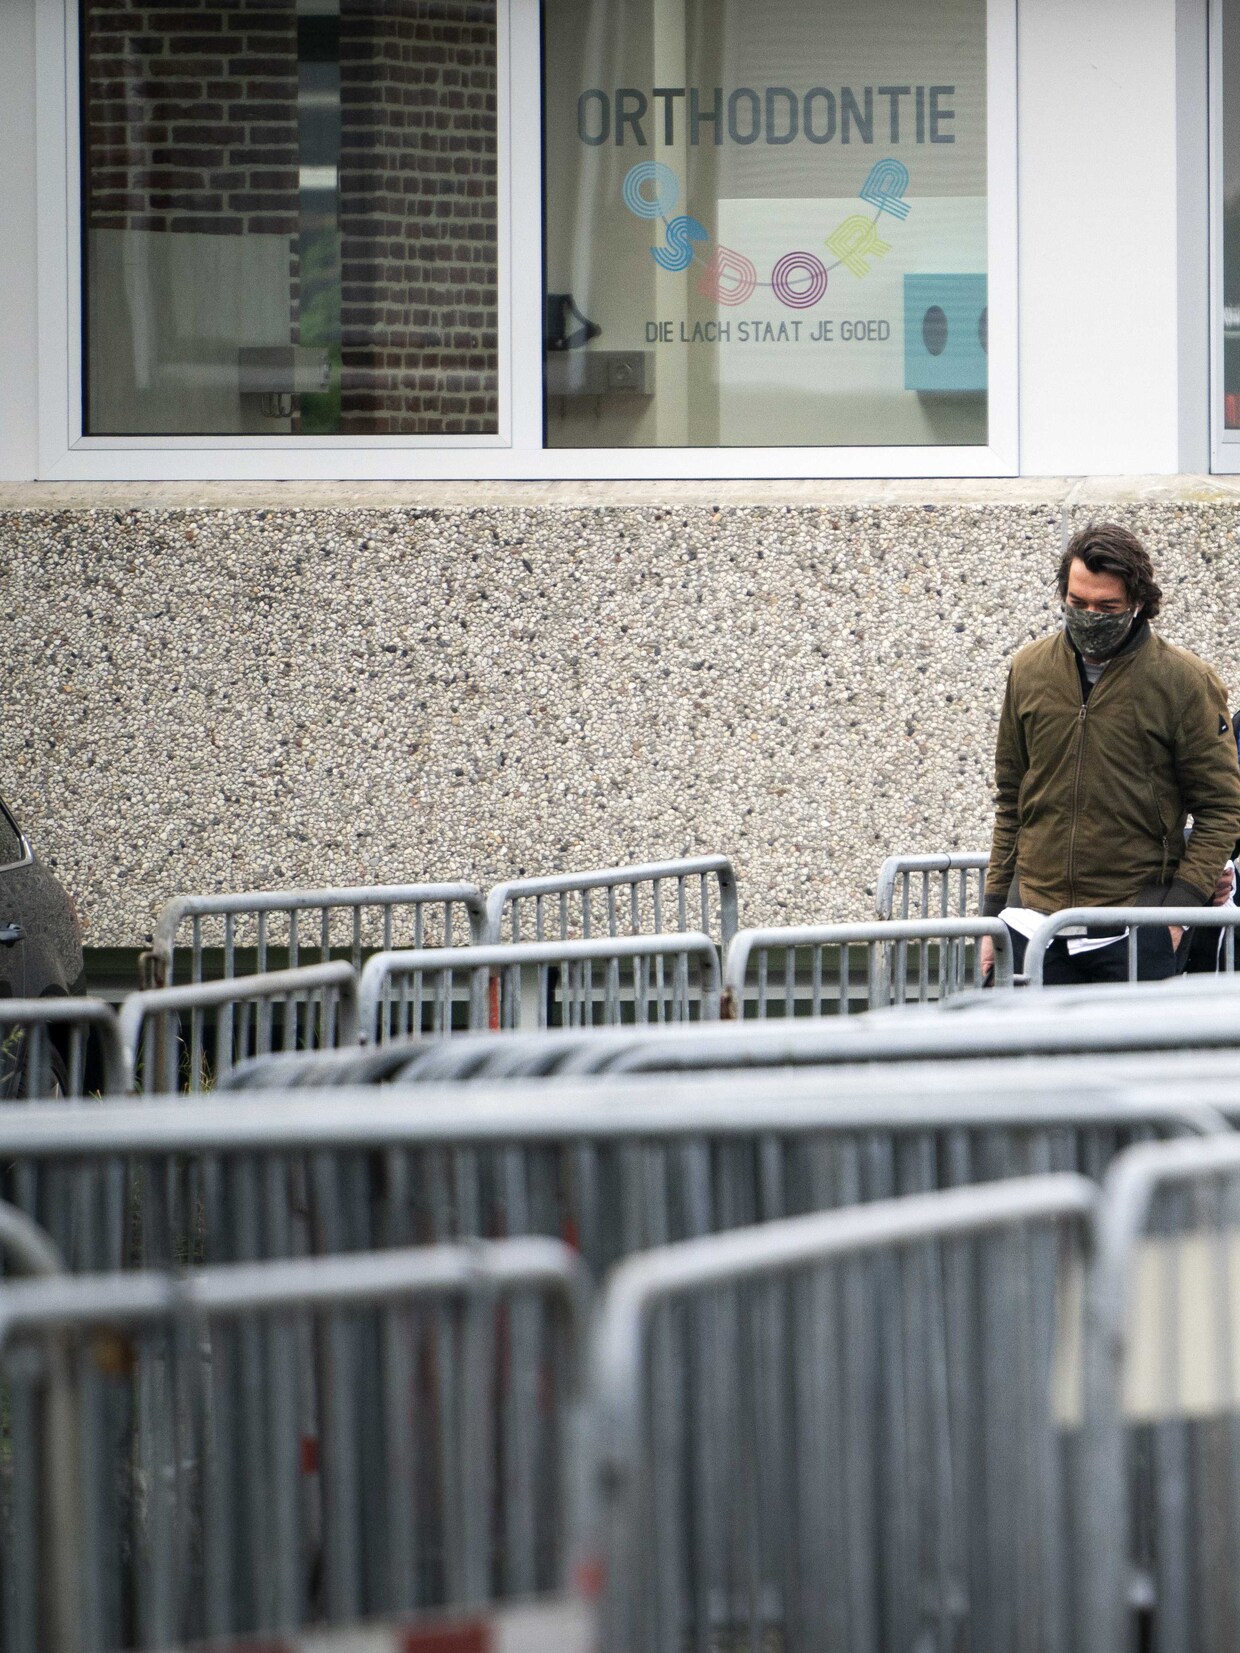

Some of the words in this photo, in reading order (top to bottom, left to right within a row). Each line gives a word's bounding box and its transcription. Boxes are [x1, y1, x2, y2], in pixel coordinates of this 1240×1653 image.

[577, 85, 956, 146] ORTHODONTIE
[645, 321, 674, 343] DIE
[680, 321, 731, 343] LACH
[738, 321, 803, 342] STAAT
[810, 320, 834, 342] JE
[840, 320, 890, 341] GOED
